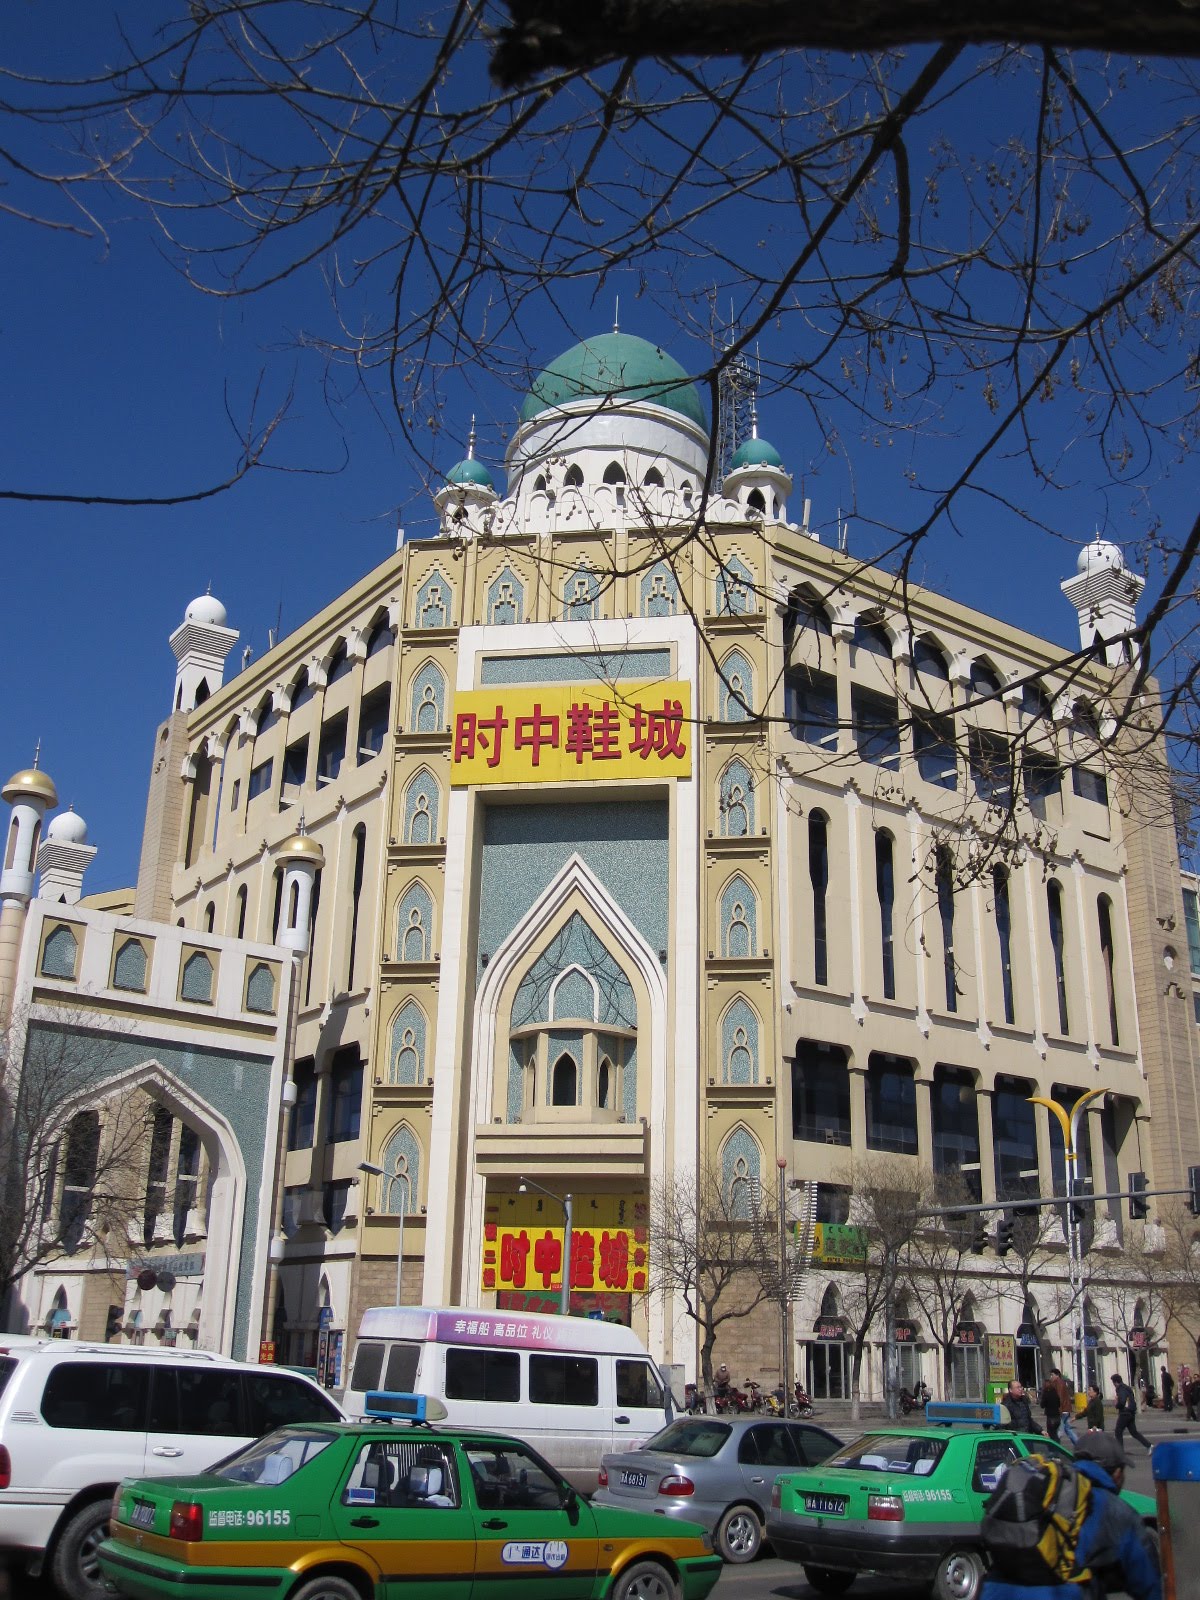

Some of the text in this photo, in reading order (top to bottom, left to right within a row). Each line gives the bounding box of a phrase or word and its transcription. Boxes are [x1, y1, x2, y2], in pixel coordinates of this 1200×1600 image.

[454, 699, 687, 768] 时中鞋城
[500, 1230, 629, 1290] 时中鞋城
[454, 1320, 489, 1336] 幸福船
[493, 1323, 528, 1338] 高品位
[531, 1325, 553, 1340] 礼仪
